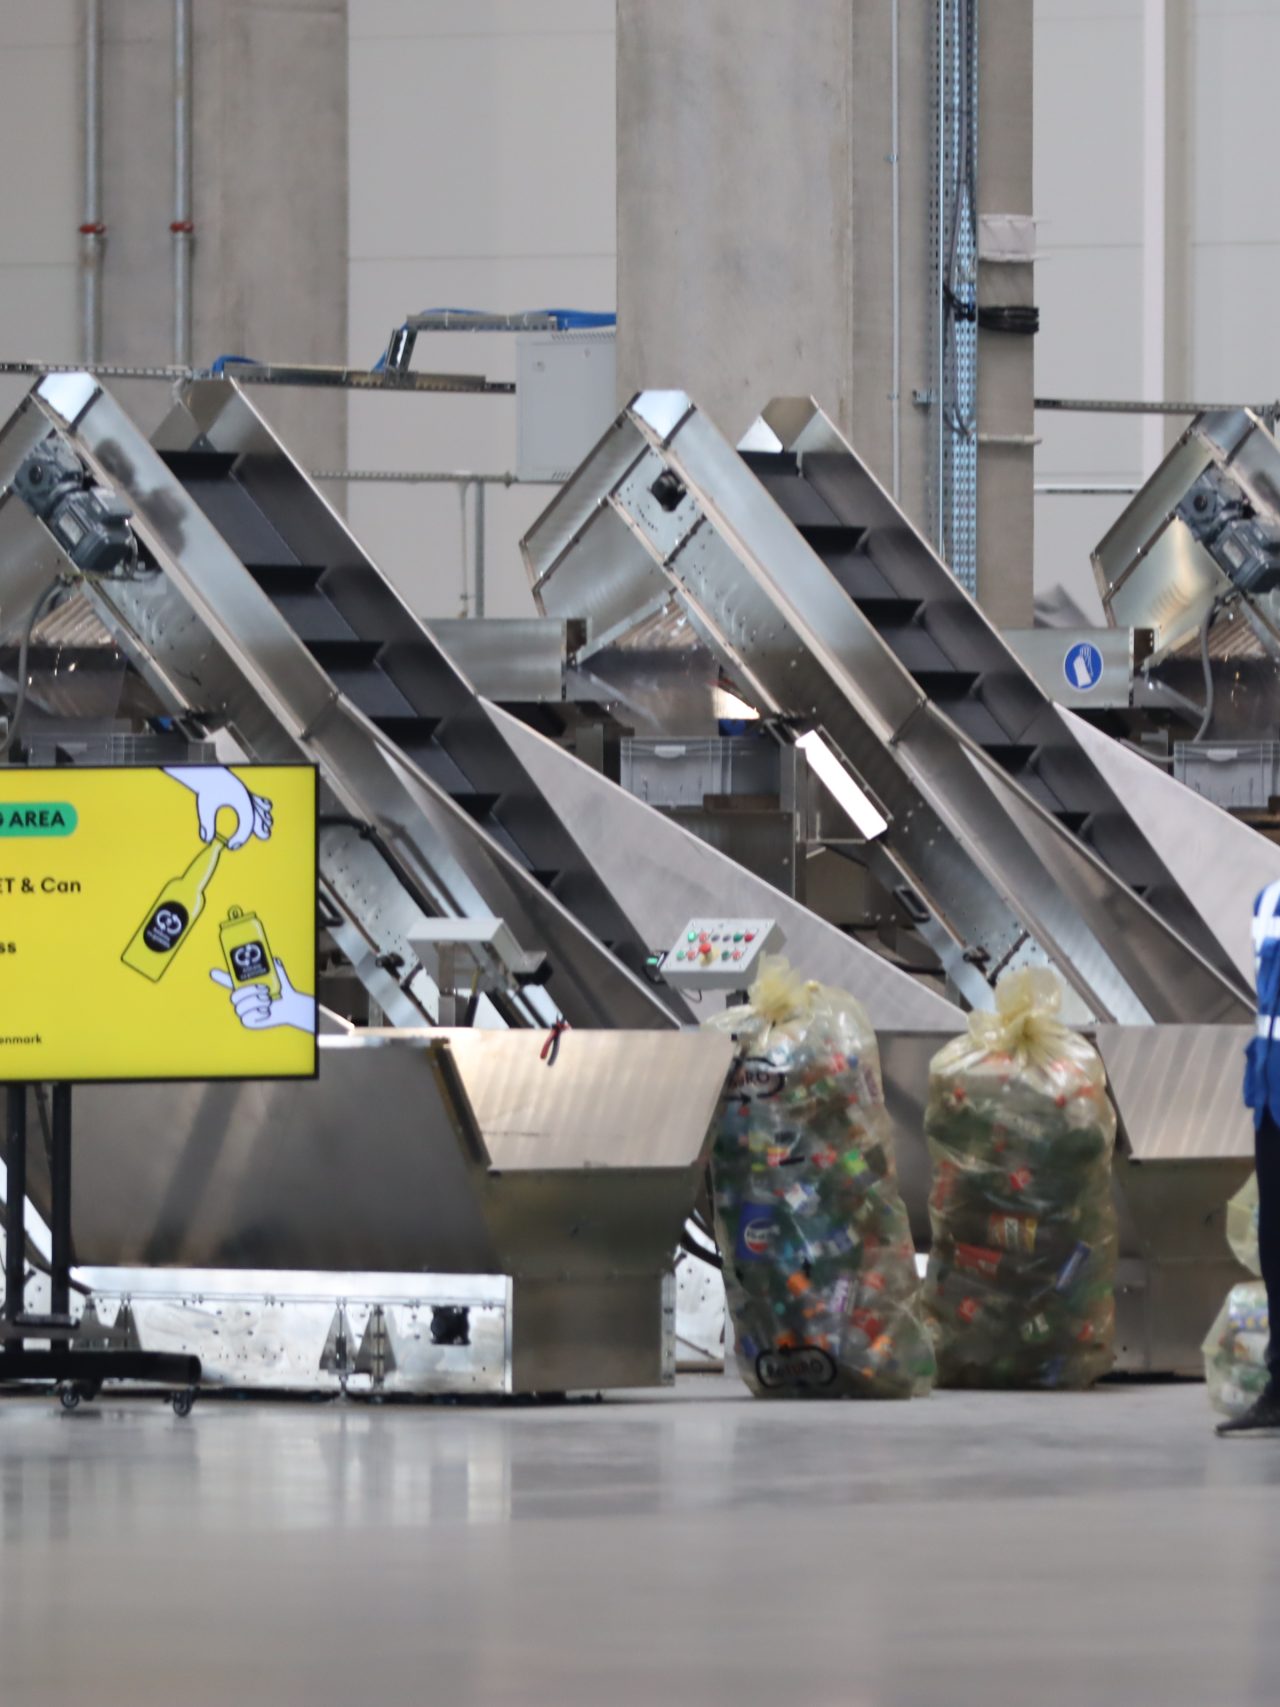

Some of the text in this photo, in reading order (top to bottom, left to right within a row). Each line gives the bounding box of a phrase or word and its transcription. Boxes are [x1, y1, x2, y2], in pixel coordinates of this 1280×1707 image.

[9, 810, 66, 828] AREA
[21, 877, 34, 893] &
[41, 876, 81, 893] Can
